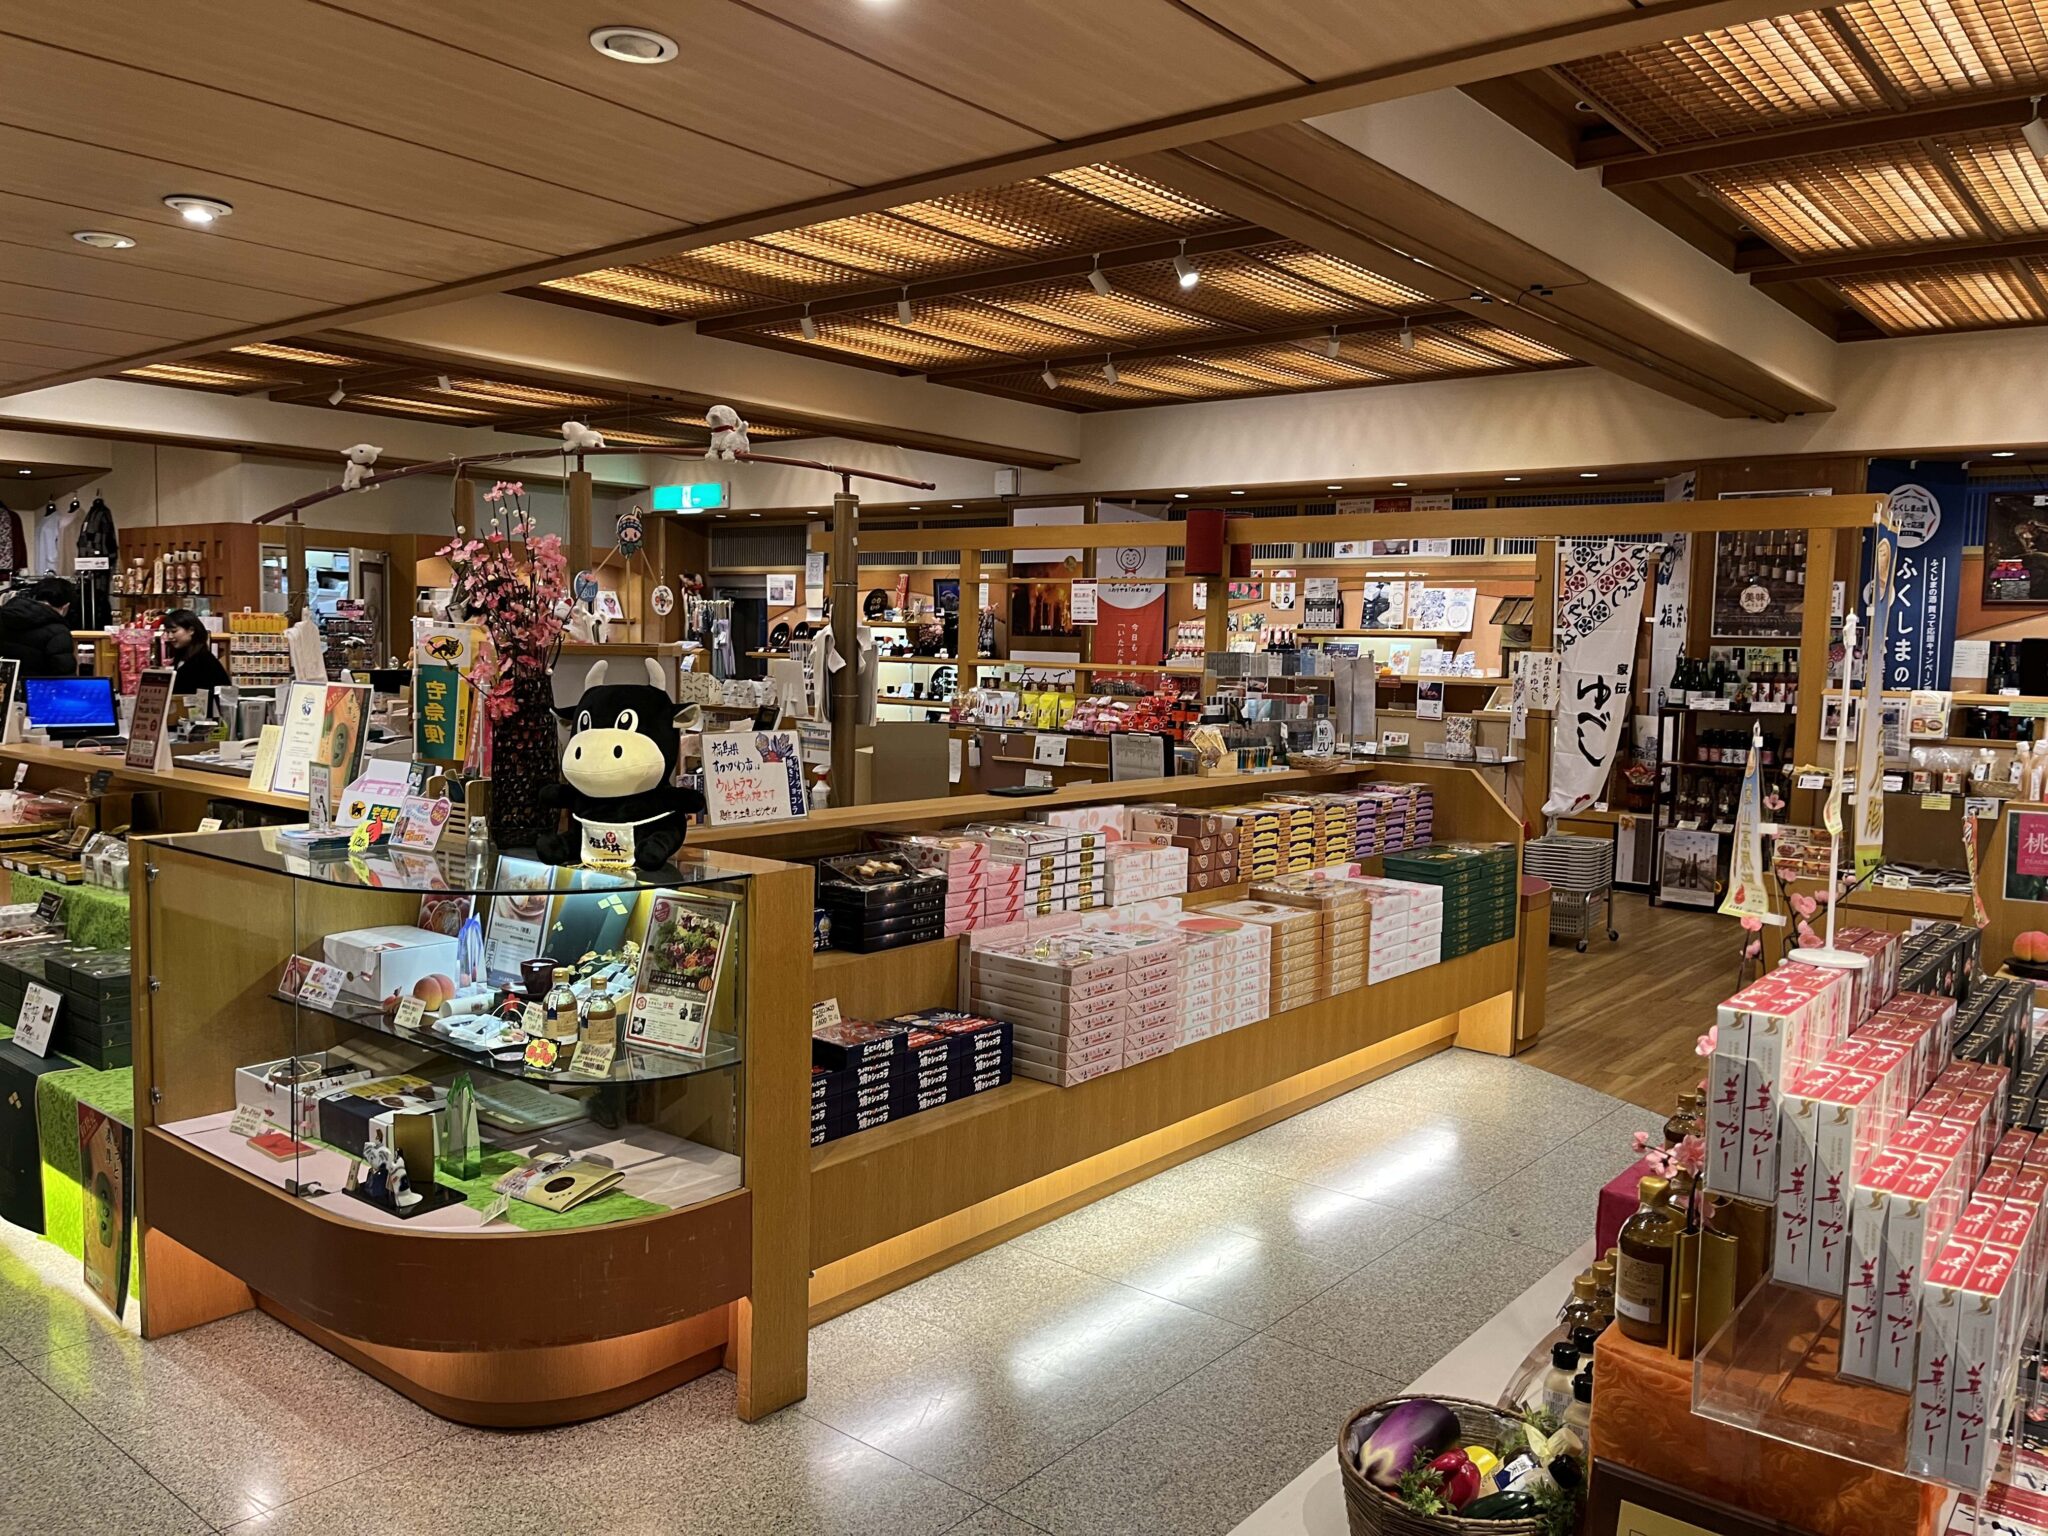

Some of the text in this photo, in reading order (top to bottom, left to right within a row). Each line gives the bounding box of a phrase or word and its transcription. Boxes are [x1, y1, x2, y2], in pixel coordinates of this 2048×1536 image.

[1890, 557, 1918, 690] ふくしまの
[1615, 663, 1629, 694] 家伝
[1577, 674, 1611, 767] ゆべし
[712, 741, 739, 757] 福島県
[716, 778, 762, 792] ウルトラマン
